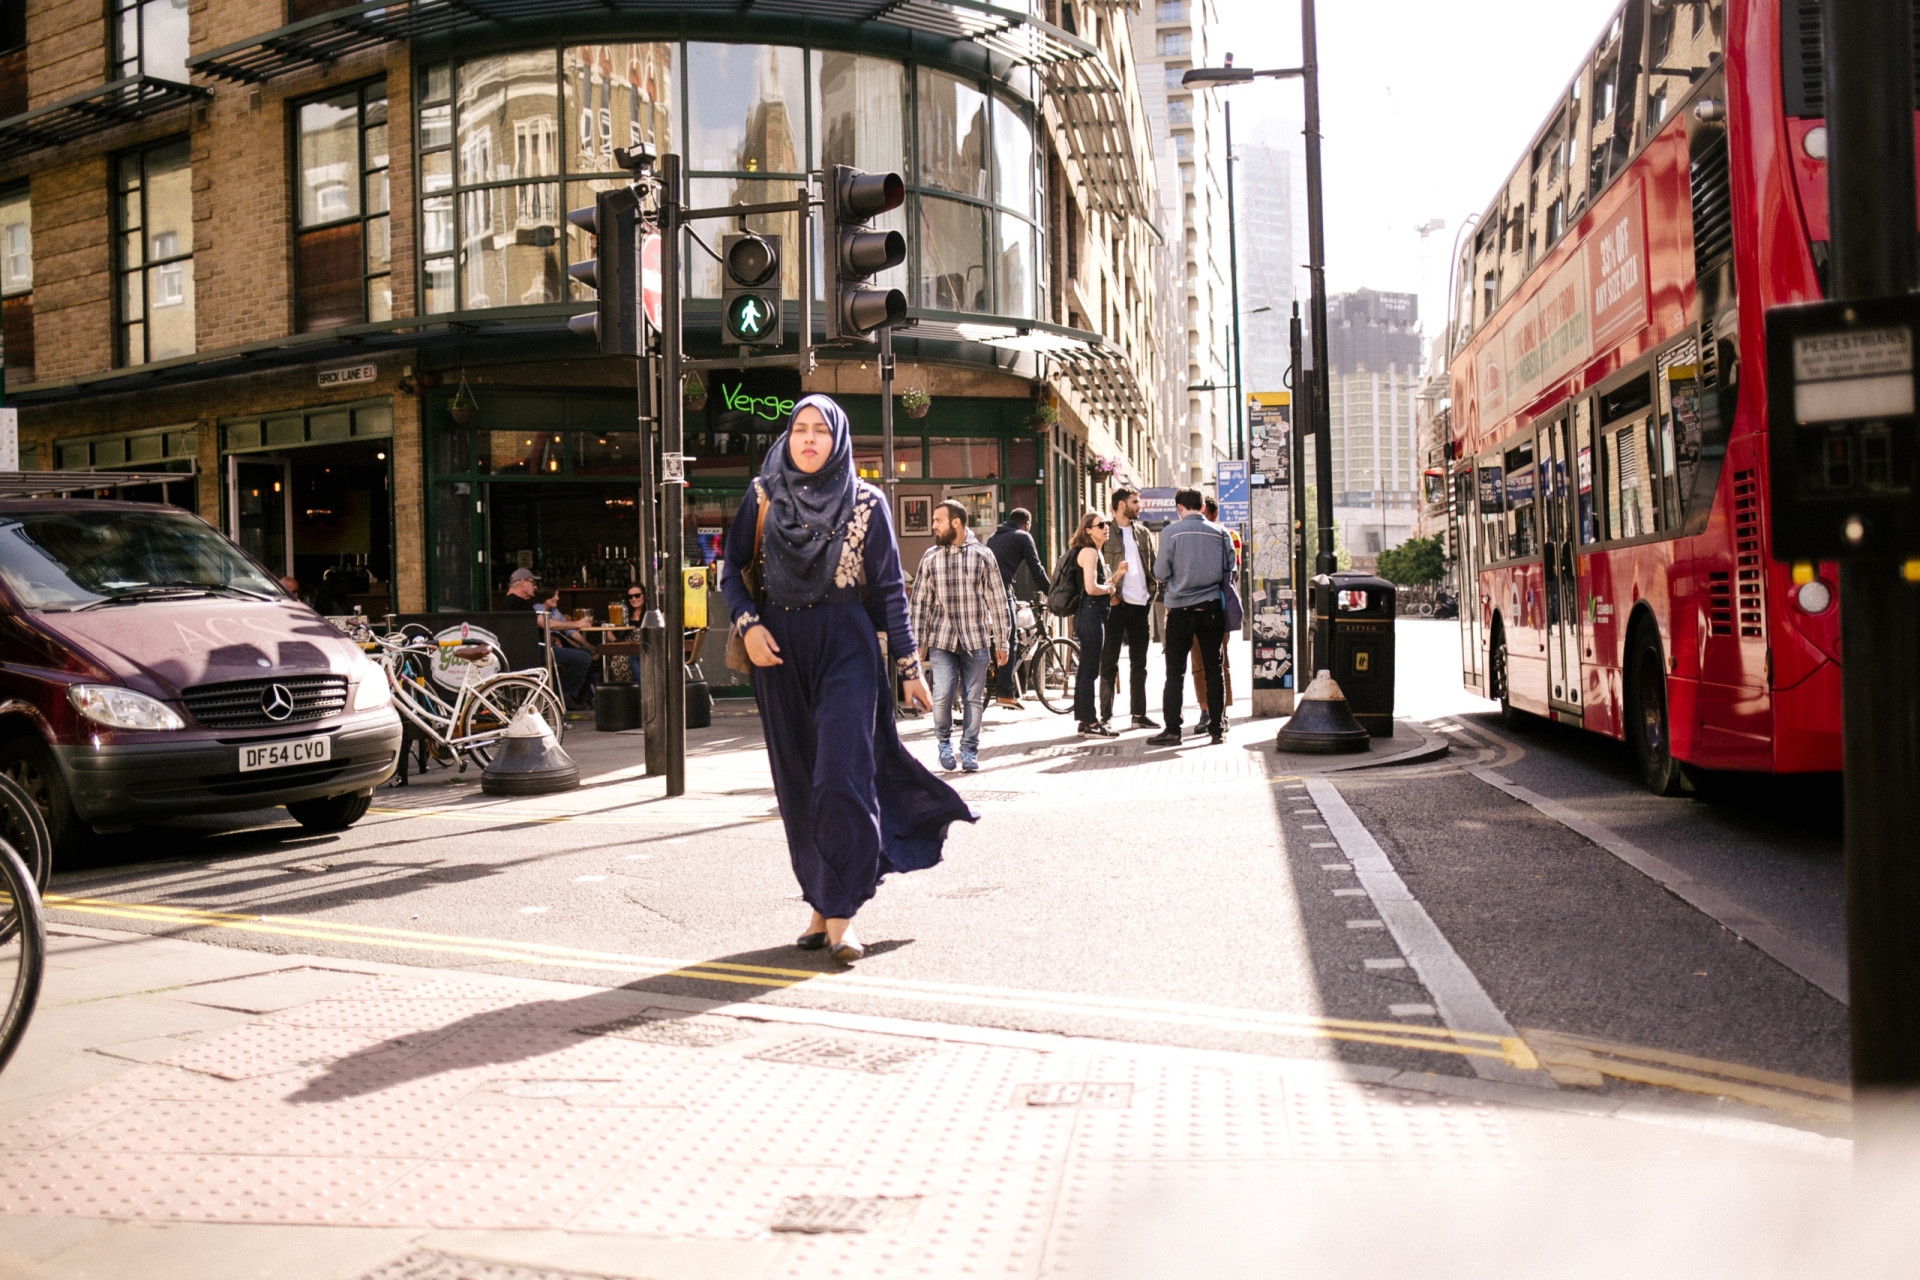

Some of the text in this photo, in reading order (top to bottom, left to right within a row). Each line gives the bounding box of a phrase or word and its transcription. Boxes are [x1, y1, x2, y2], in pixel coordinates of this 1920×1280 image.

[1615, 216, 1629, 264] OFF
[1595, 281, 1608, 317] ANY
[1802, 331, 1907, 353] PEDESTRIANS
[319, 371, 340, 385] BRICK
[341, 368, 362, 382] LANE
[721, 381, 795, 421] Verge
[1139, 498, 1176, 508] ETFRED
[1346, 624, 1377, 632] LITTER
[246, 741, 325, 768] DF54 CVO
